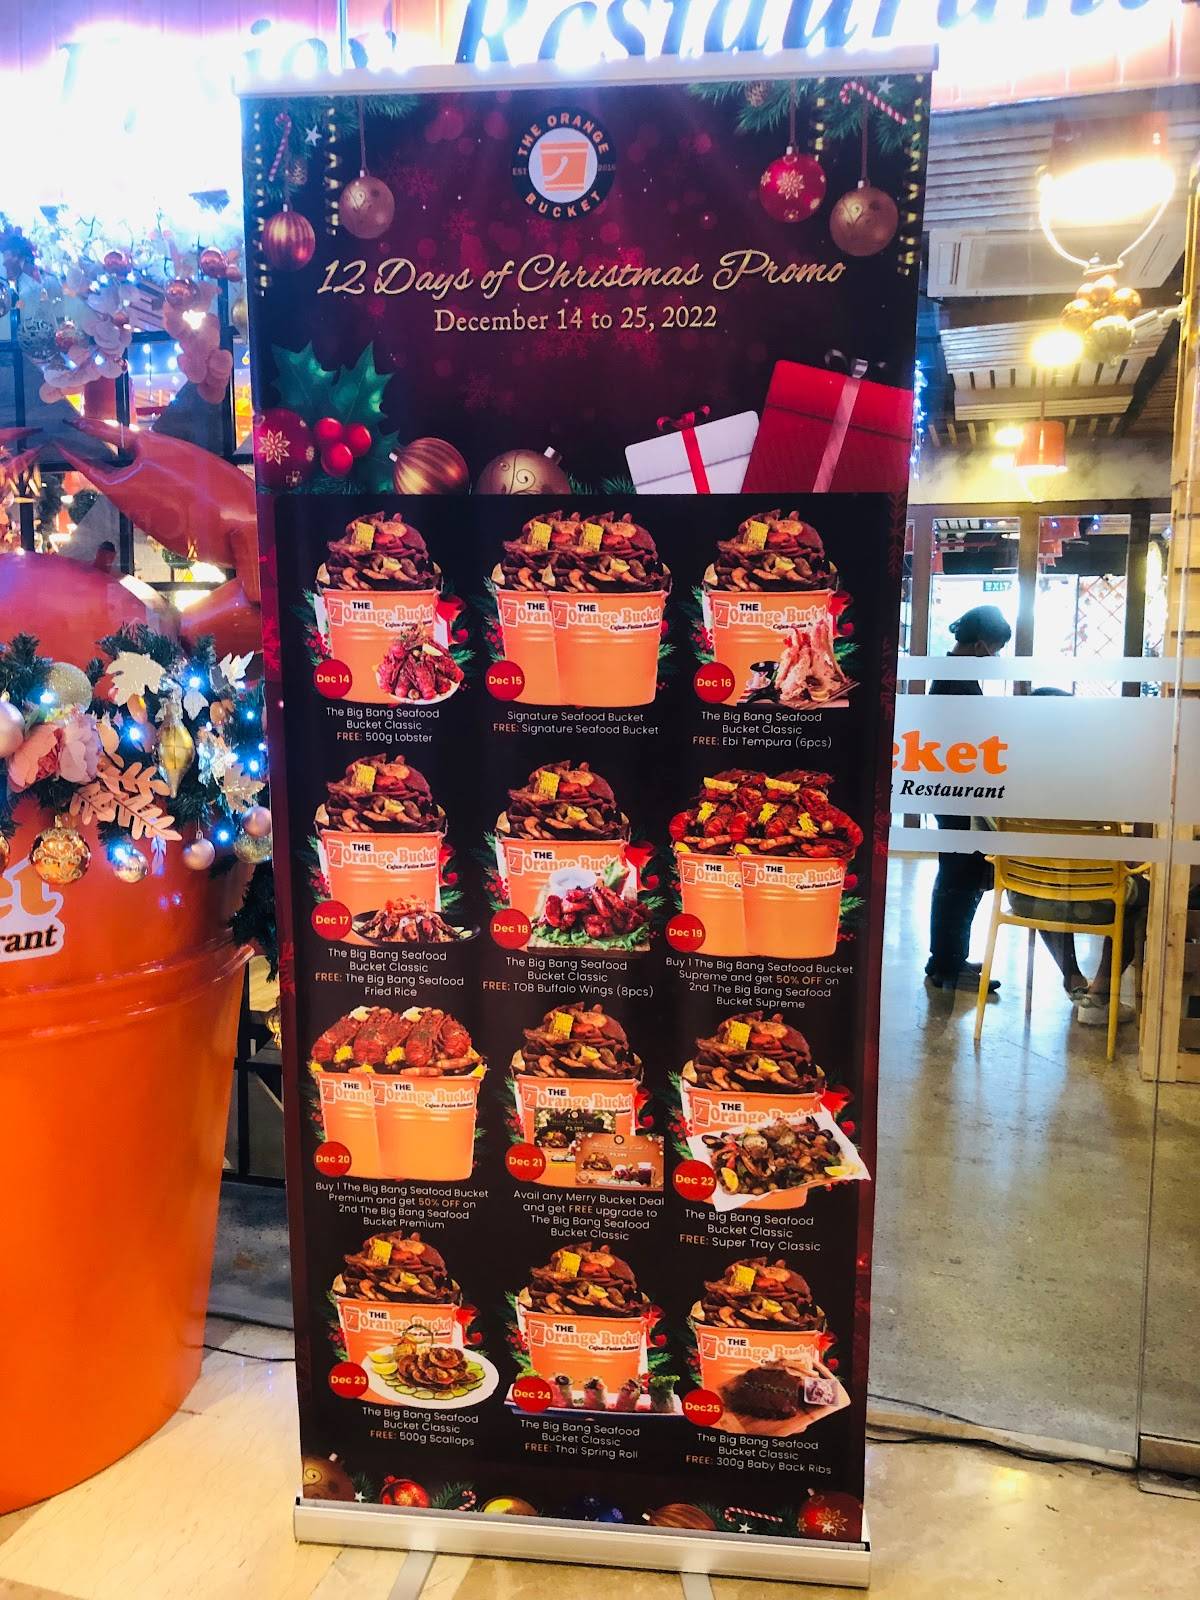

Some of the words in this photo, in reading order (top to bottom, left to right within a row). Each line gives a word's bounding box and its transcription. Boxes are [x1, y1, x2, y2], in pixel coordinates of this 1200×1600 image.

[517, 123, 541, 156] THE
[547, 112, 609, 154] ORANGE
[525, 191, 600, 218] BUCKET
[317, 260, 367, 295] 12
[373, 257, 473, 300] Days
[481, 260, 514, 299] of
[517, 253, 703, 292] Christmas
[713, 249, 845, 290] Promo
[434, 309, 548, 332] December
[557, 309, 582, 330] 14
[591, 312, 612, 329] to
[621, 306, 654, 331] 25,
[661, 305, 717, 328] 2022
[984, 581, 1011, 591] EXIT
[577, 604, 596, 612] THE
[568, 609, 619, 628] Orange
[621, 607, 662, 622] Bucket
[316, 674, 337, 683] Dec
[339, 674, 350, 683] 14
[488, 676, 509, 685] Dec
[511, 676, 522, 685] 15
[696, 678, 717, 687] Dec
[720, 678, 732, 687] 16
[326, 707, 345, 716] The
[347, 708, 363, 720] Big
[365, 708, 394, 720] Bang
[396, 708, 440, 718] Seafood
[507, 711, 559, 723] Signature
[561, 711, 605, 721] Seafood
[608, 712, 644, 722] Bucket
[701, 712, 721, 721] The
[723, 712, 741, 724] Big
[743, 712, 773, 724] Bang
[775, 712, 822, 722] Seafood
[346, 720, 382, 729] Bucket
[384, 720, 422, 730] Classic
[521, 723, 573, 735] Signature
[575, 724, 620, 734] Seafood
[622, 725, 659, 735] Bucket
[722, 725, 760, 734] Bucket
[762, 725, 803, 735] Classic
[365, 732, 393, 744] 500g
[395, 732, 433, 742] Lobster
[692, 736, 720, 746] FREE:
[722, 736, 739, 746] Ebi
[742, 737, 792, 748] Tempura
[795, 736, 832, 749] (6pcs)
[900, 779, 1006, 799] Restaurant
[352, 843, 371, 851] THE
[342, 846, 394, 866] Orange
[399, 847, 438, 863] Bucket
[315, 915, 337, 925] Dec
[339, 916, 349, 925] 17
[493, 923, 515, 933] Dec
[517, 924, 529, 934] 18
[668, 928, 690, 937] Dec
[692, 928, 703, 938] 19
[328, 948, 348, 958] The
[350, 949, 367, 961] Big
[370, 950, 399, 961] Bang
[401, 950, 447, 961] Seafood
[350, 961, 386, 972] Bucket
[389, 962, 429, 973] Classic
[506, 957, 526, 966] The
[528, 958, 546, 970] Big
[548, 958, 578, 970] Bang
[580, 959, 628, 970] Seafood
[315, 972, 343, 982] FREE:
[345, 973, 365, 983] The
[367, 974, 384, 986] Big
[387, 975, 416, 987] Bang
[418, 975, 464, 986] Seafood
[527, 971, 565, 981] Bucket
[567, 972, 608, 982] Classic
[364, 986, 392, 996] Fried
[395, 987, 418, 997] Rice
[482, 982, 510, 991] FREE:
[513, 982, 535, 992] TOB
[537, 983, 577, 993] Buffalo
[579, 984, 614, 997] Wings
[616, 986, 654, 998] (8pcs)
[316, 1155, 336, 1163] Dec
[338, 1155, 350, 1164] 20
[508, 1156, 530, 1166] Dec
[532, 1157, 543, 1167] 21
[675, 1175, 698, 1185] Dec
[699, 1176, 714, 1186] 22
[513, 1190, 540, 1200] Avail
[542, 1192, 563, 1203] any
[565, 1193, 597, 1204] Merry
[599, 1194, 637, 1205] Bucket
[639, 1196, 665, 1206] Deal
[522, 1203, 545, 1212] and
[547, 1205, 566, 1215] get
[568, 1205, 593, 1214] FREE
[595, 1206, 644, 1219] upgrade
[646, 1208, 658, 1218] to
[685, 1209, 706, 1220] The
[708, 1211, 727, 1224] Big
[730, 1213, 761, 1226] Bang
[764, 1214, 814, 1226] Seafood
[530, 1215, 550, 1224] The
[552, 1216, 570, 1228] Big
[572, 1217, 601, 1229] Bang
[604, 1218, 650, 1230] Seafood
[550, 1228, 588, 1238] Bucket
[590, 1229, 630, 1241] Classic
[707, 1224, 747, 1235] Bucket
[750, 1226, 794, 1238] Classic
[679, 1234, 709, 1245] FREE:
[712, 1237, 746, 1249] Super
[749, 1239, 775, 1251] Tray
[778, 1240, 821, 1251] Classic
[555, 1324, 574, 1333] THE
[545, 1328, 597, 1347] Orange
[600, 1330, 641, 1345] Bucket
[331, 1375, 352, 1384] Dec
[354, 1376, 367, 1385] 23
[514, 1389, 535, 1399] Dec
[537, 1390, 551, 1400] 24
[362, 1406, 382, 1416] The
[384, 1408, 401, 1420] Big
[403, 1410, 431, 1422] Bang
[434, 1411, 479, 1424] Seafood
[383, 1420, 420, 1430] Bucket
[421, 1422, 461, 1434] Classic
[370, 1430, 397, 1440] FREE:
[399, 1432, 427, 1444] 500g
[429, 1434, 475, 1447] Scallops
[697, 1432, 717, 1443] The
[719, 1434, 737, 1446] Big
[739, 1436, 769, 1448] Bang
[771, 1439, 819, 1450] Seafood
[718, 1446, 756, 1457] Bucket
[758, 1449, 800, 1460] Classic
[686, 1455, 713, 1465] FREE:
[716, 1457, 745, 1470] 300g
[747, 1459, 776, 1471] Baby
[778, 1462, 805, 1472] Back
[808, 1464, 832, 1475] Ribs
